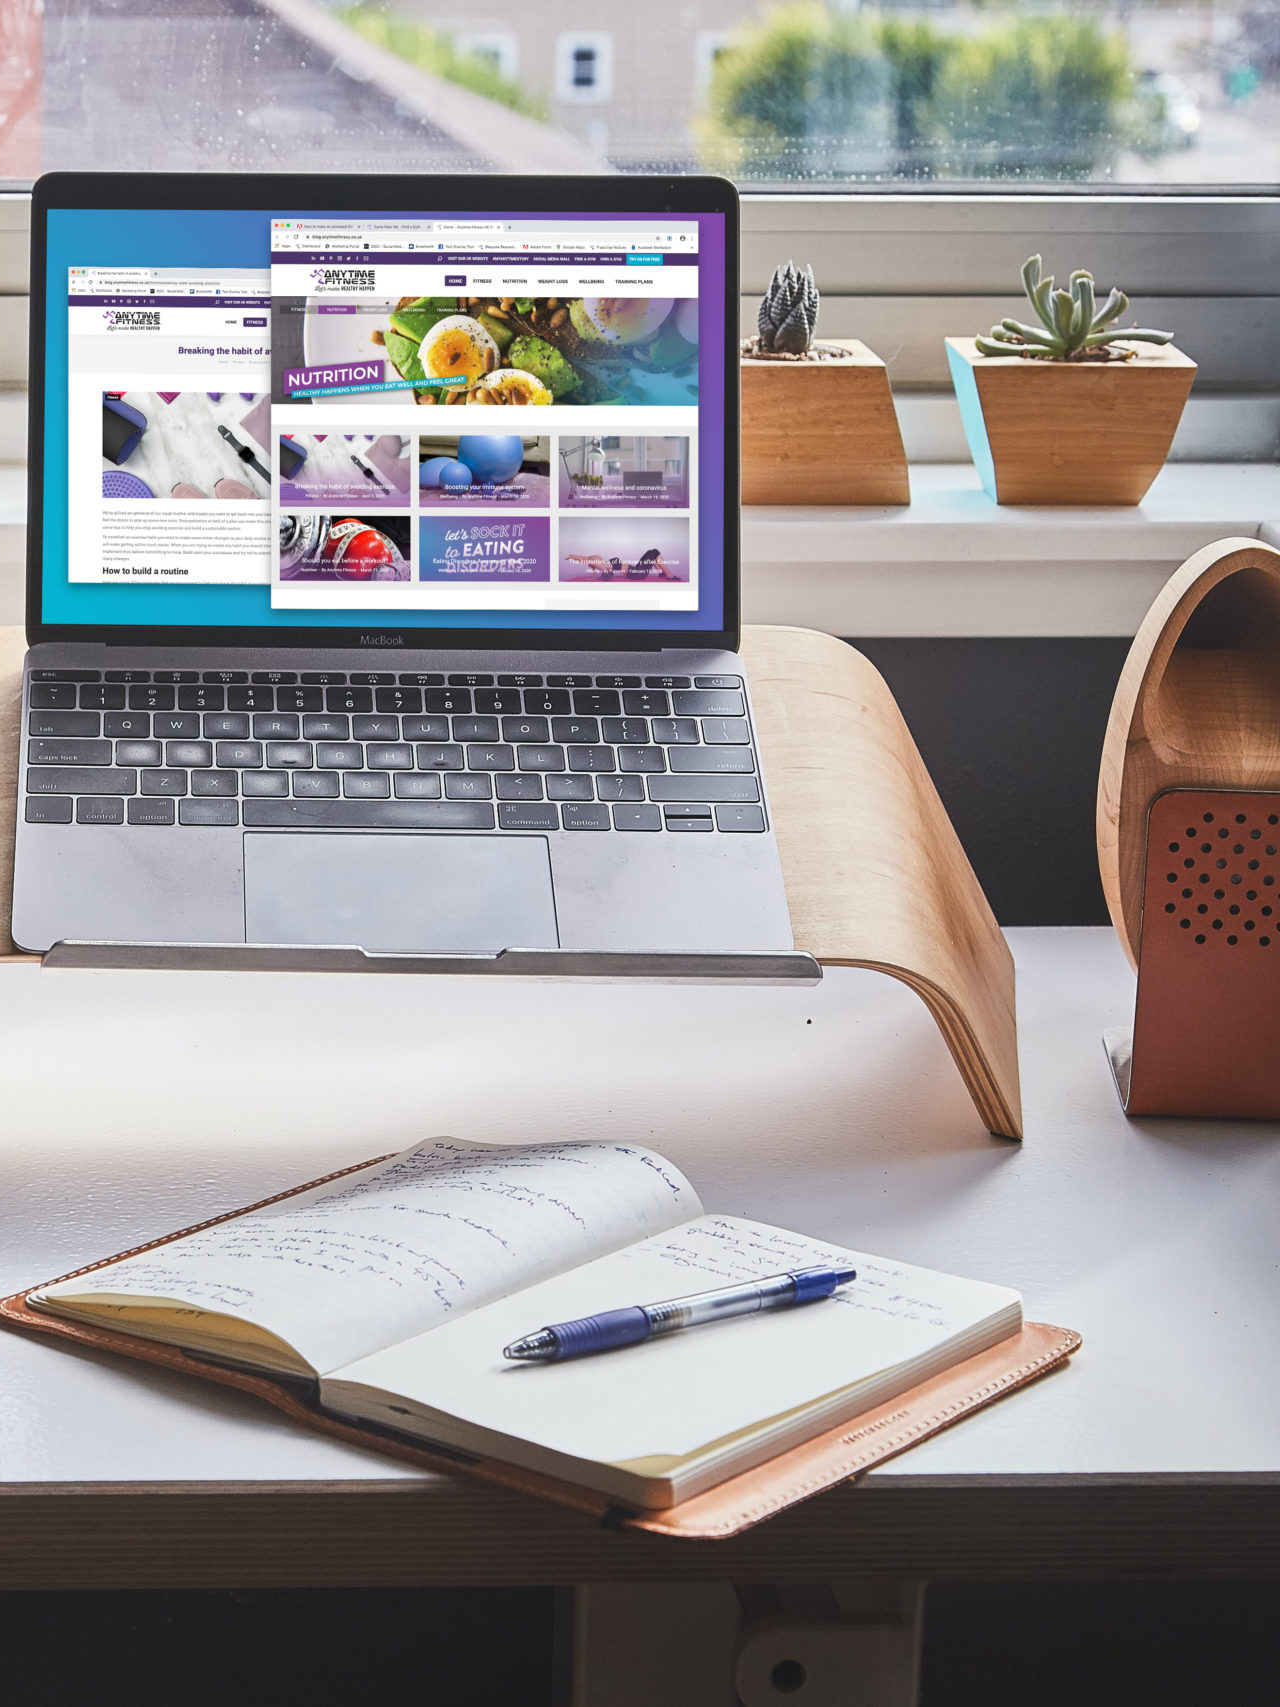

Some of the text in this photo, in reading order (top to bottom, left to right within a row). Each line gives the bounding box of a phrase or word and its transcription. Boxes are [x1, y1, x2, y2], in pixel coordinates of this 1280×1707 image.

[324, 270, 375, 278] ANYTIME
[178, 347, 214, 356] Breaking
[217, 347, 230, 355] the
[232, 347, 252, 355] habit
[254, 347, 263, 355] of
[288, 365, 378, 387] NUTRITION
[445, 376, 465, 384] GREAT
[445, 524, 525, 541] let's SOCK IT
[445, 540, 524, 558] to EATING
[447, 558, 524, 573] DISORDERS
[132, 567, 151, 575] build
[161, 567, 189, 575] routine
[361, 635, 404, 645] MacBook
[198, 698, 205, 706] 3
[345, 700, 353, 708] 6
[395, 700, 402, 708] 7
[445, 701, 452, 709] 8
[122, 721, 131, 729] Q
[170, 721, 182, 729] W
[222, 722, 230, 730] E
[210, 779, 219, 787] X
[311, 780, 321, 788] V
[413, 782, 422, 790] N
